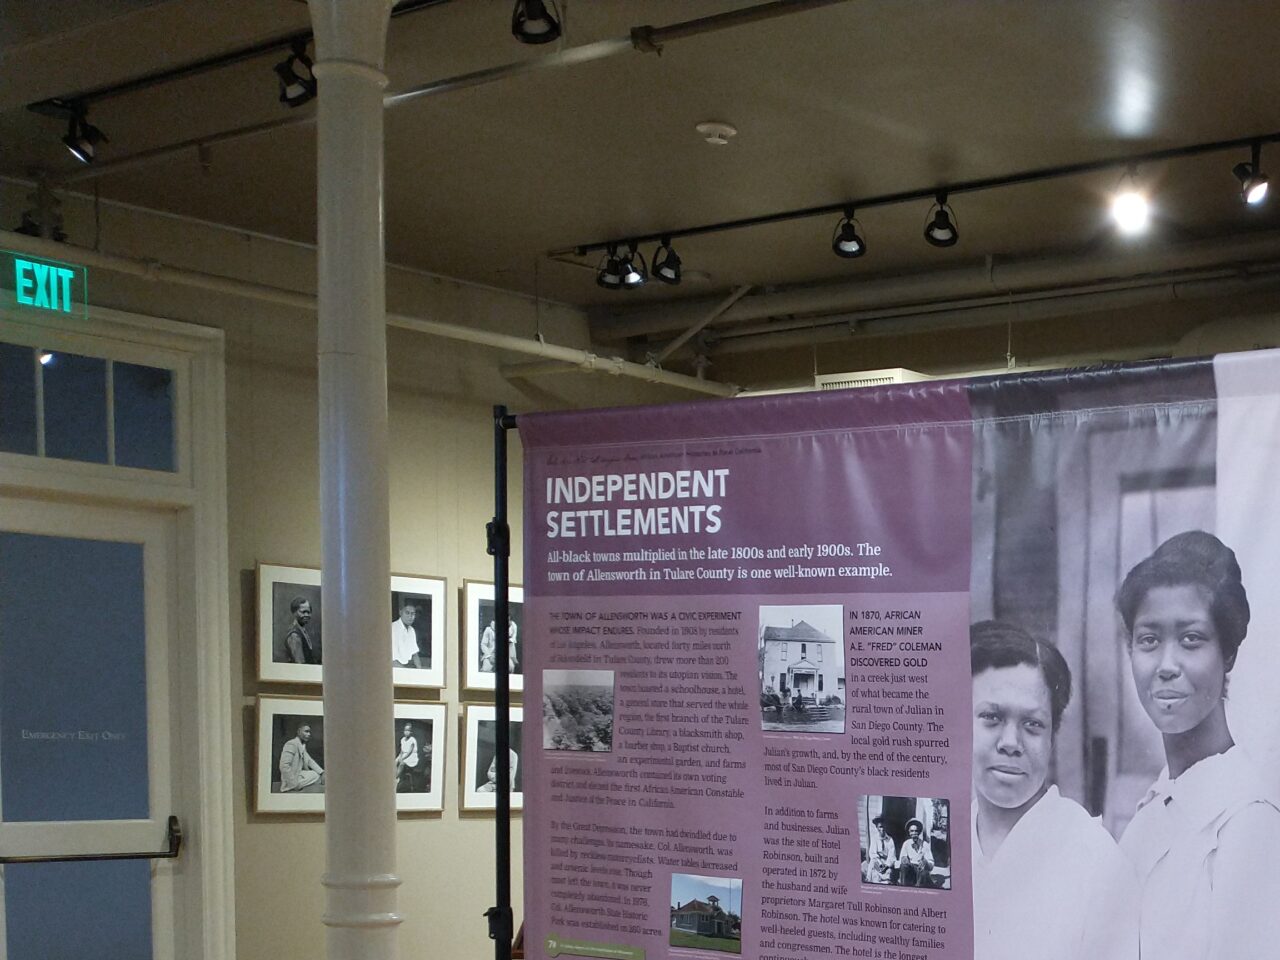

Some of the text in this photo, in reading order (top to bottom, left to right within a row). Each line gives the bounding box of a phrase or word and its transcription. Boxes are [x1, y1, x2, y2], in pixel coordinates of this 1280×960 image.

[15, 259, 74, 312] EXIT
[546, 468, 729, 504] INDEPENDENT
[546, 505, 722, 538] SETTLEMENTS
[547, 542, 881, 563] All-black towns multiplied in the late 1800s and early 1900s. The
[548, 563, 892, 581] town of Allensworth in Tulare County is one well-known example.
[650, 612, 668, 620] WAS
[670, 612, 676, 620] A
[698, 611, 742, 620] EXPERIMENT
[849, 610, 920, 620] IN 1870, AFRICAN
[849, 626, 923, 635] AMERICAN MINER
[850, 642, 864, 650] A.E.
[899, 642, 941, 651] COLEMAN
[850, 657, 927, 667] DISCOVERED GOLD
[851, 673, 927, 684] in a creek just west
[851, 688, 929, 699] of what became the
[852, 703, 944, 715] rural town of Julian in
[851, 720, 866, 729] San
[868, 720, 890, 732] Diego
[926, 721, 943, 731] The
[851, 735, 949, 748] local gold rush spurred
[792, 749, 820, 759] growth,
[841, 750, 851, 761] by
[853, 750, 866, 760] the
[868, 751, 884, 760] end
[886, 751, 894, 761] of
[896, 752, 910, 761] the
[912, 754, 947, 765] century,
[783, 763, 790, 772] of
[792, 763, 805, 772] San
[807, 764, 827, 775] Diego
[830, 765, 865, 777] County's
[867, 766, 889, 776] black
[891, 767, 929, 778] residents
[764, 775, 817, 788] lived in Julian.
[765, 806, 838, 819] In addition to farms
[764, 821, 779, 830] and
[825, 824, 850, 835] Julian
[763, 836, 840, 849] was the site of Hotel
[804, 852, 822, 863] built
[824, 855, 839, 864] and
[762, 867, 838, 880] operated in 1872 by
[762, 879, 848, 894] the husband and wife
[761, 896, 946, 918] proprietors Margaret Tull Robinson and Albert
[761, 909, 945, 935] Robinson. The hotel was known for catering to
[760, 924, 805, 936] well-heeled
[838, 931, 876, 944] including
[878, 935, 910, 947] wealthy
[912, 937, 944, 949] families
[759, 939, 775, 948] and
[777, 942, 832, 953] congressmen.
[834, 945, 850, 955] The
[852, 946, 872, 957] hotel
[874, 949, 881, 958] is
[883, 949, 897, 959] the
